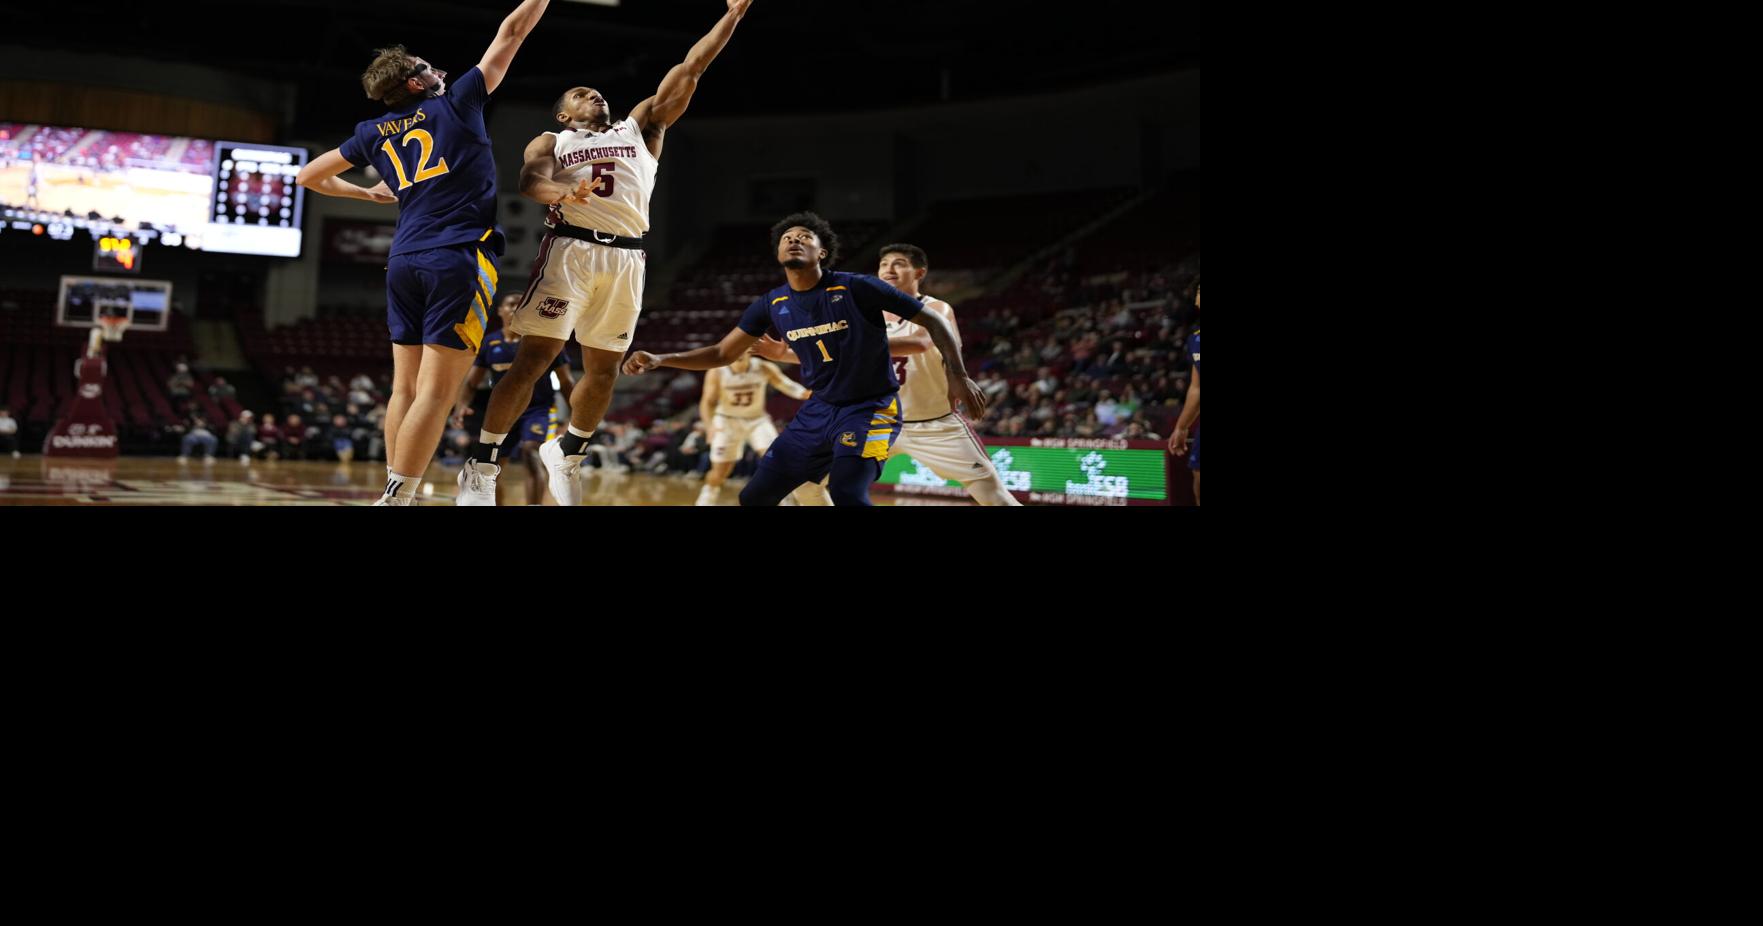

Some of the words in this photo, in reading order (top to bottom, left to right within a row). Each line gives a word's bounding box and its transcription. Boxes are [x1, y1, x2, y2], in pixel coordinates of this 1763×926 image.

[381, 128, 449, 191] 12
[558, 146, 637, 169] MASSACHUSETTS
[592, 162, 615, 197] 5
[816, 339, 833, 362] 1
[731, 391, 754, 407] 33
[1067, 438, 1128, 450] SPRINGFIELD
